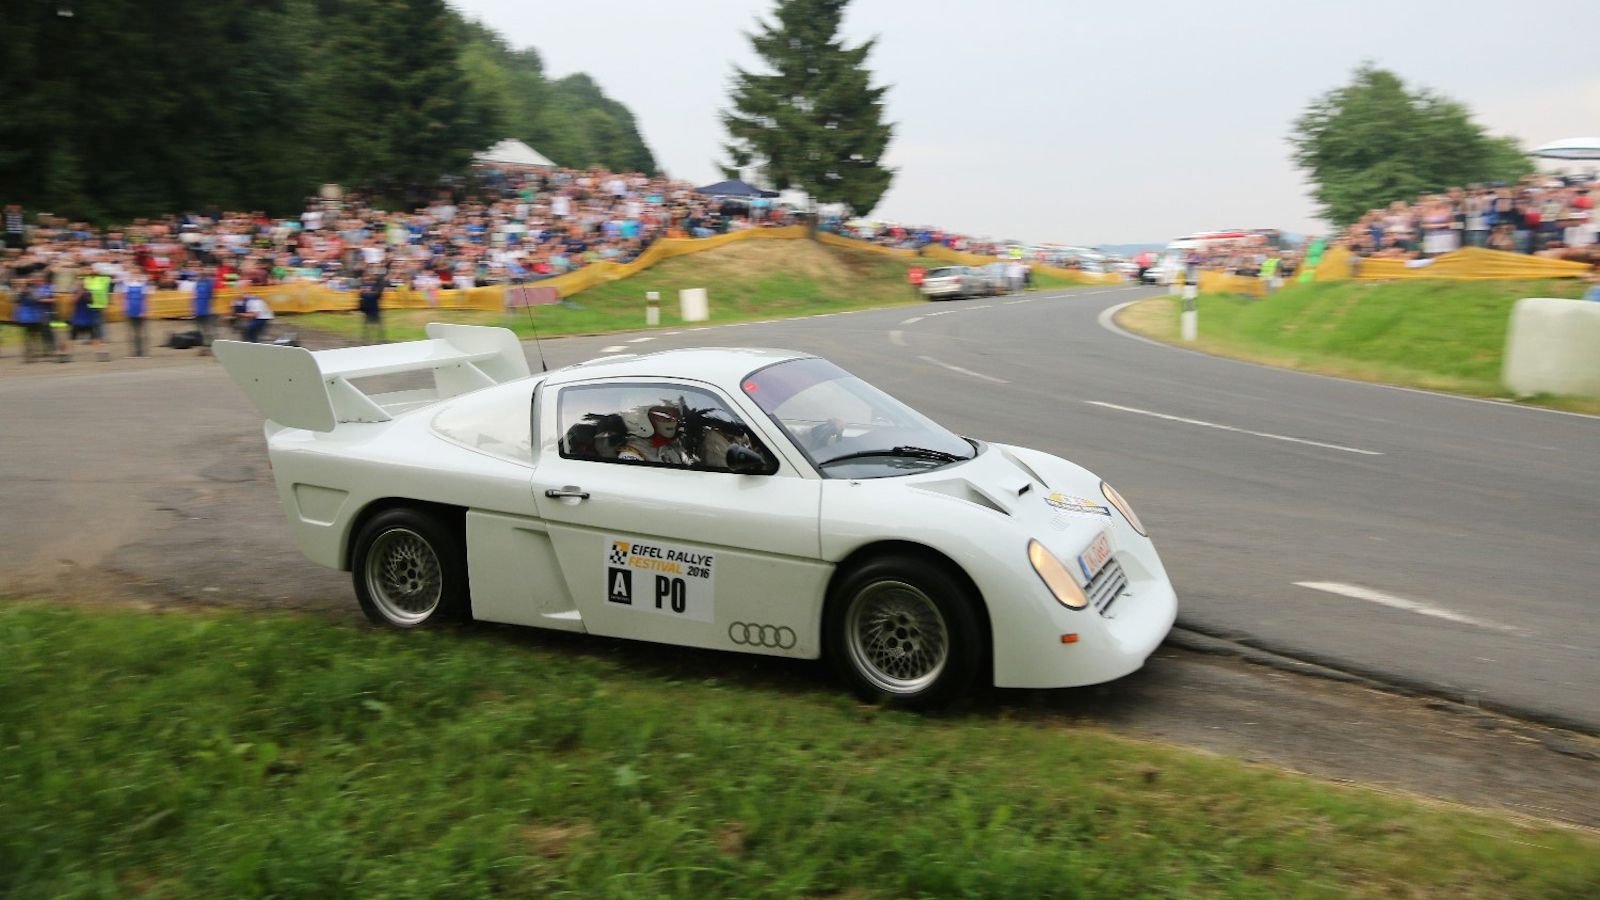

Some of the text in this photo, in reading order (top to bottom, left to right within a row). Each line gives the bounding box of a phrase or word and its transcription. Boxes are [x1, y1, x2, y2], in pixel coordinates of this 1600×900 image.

[631, 544, 714, 567] EIFEL RALLYE
[627, 556, 711, 579] FESTIVAL 2016
[612, 571, 628, 597] A
